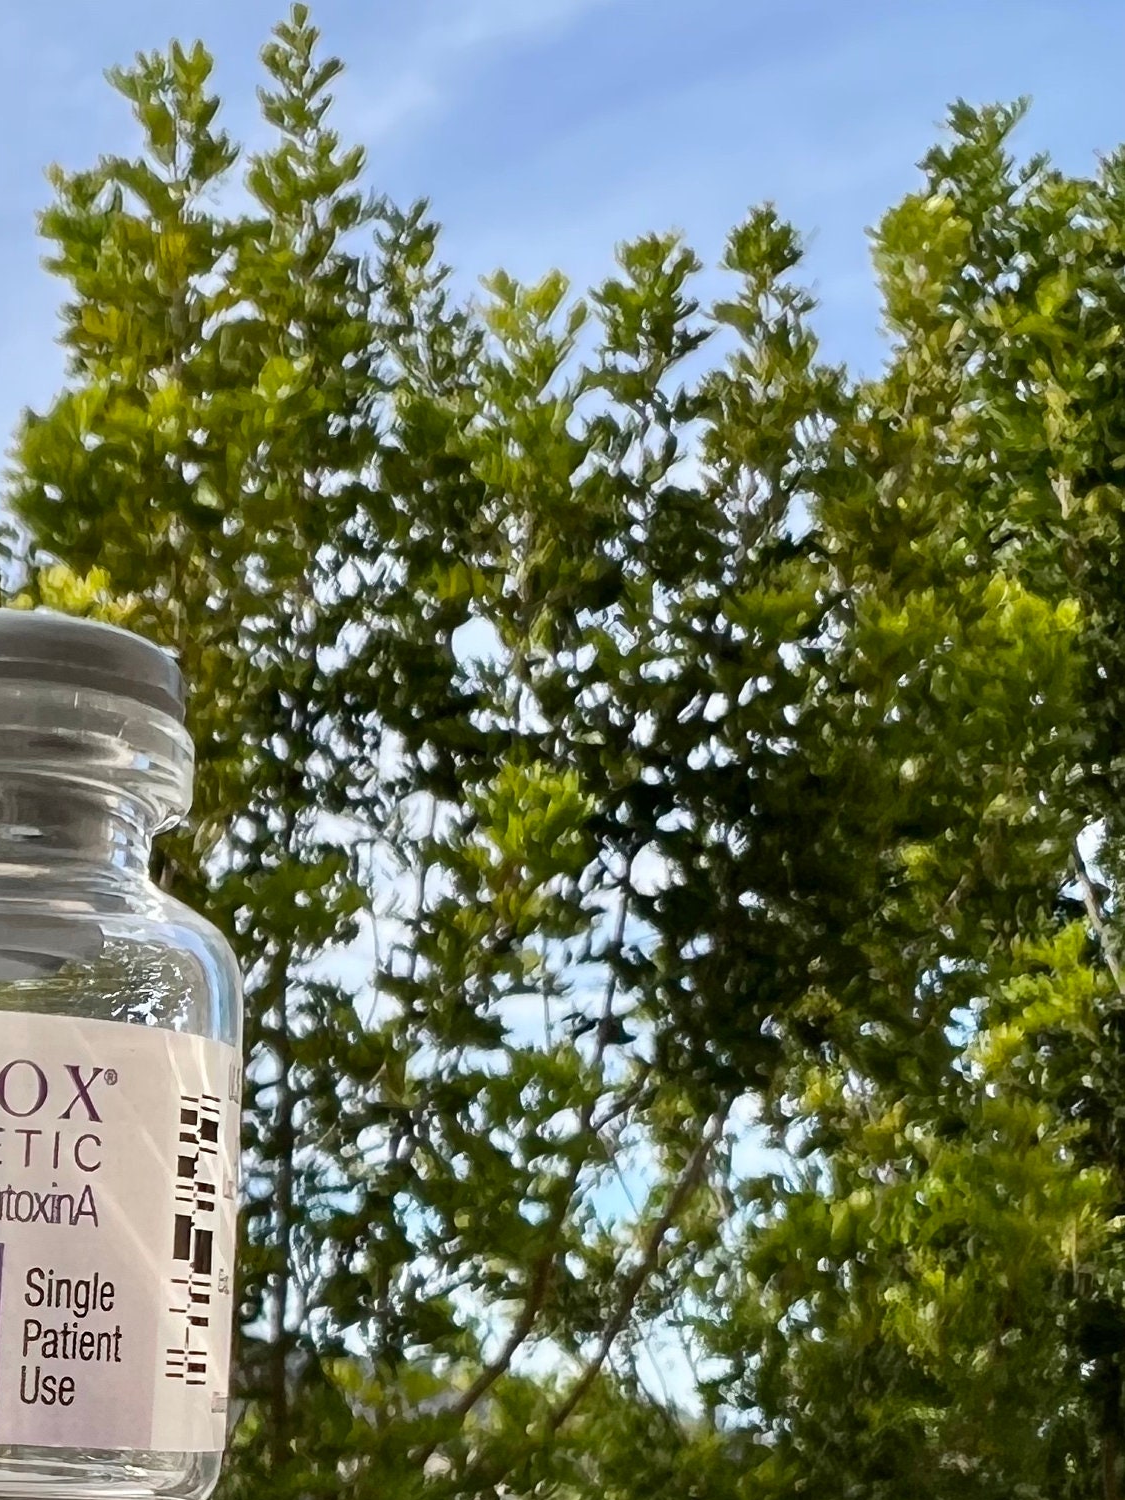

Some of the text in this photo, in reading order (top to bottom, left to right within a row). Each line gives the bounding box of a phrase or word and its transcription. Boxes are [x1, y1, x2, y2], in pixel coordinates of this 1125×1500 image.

[24, 1267, 115, 1318] Single
[22, 1319, 122, 1362] Patient
[20, 1366, 75, 1406] Use
